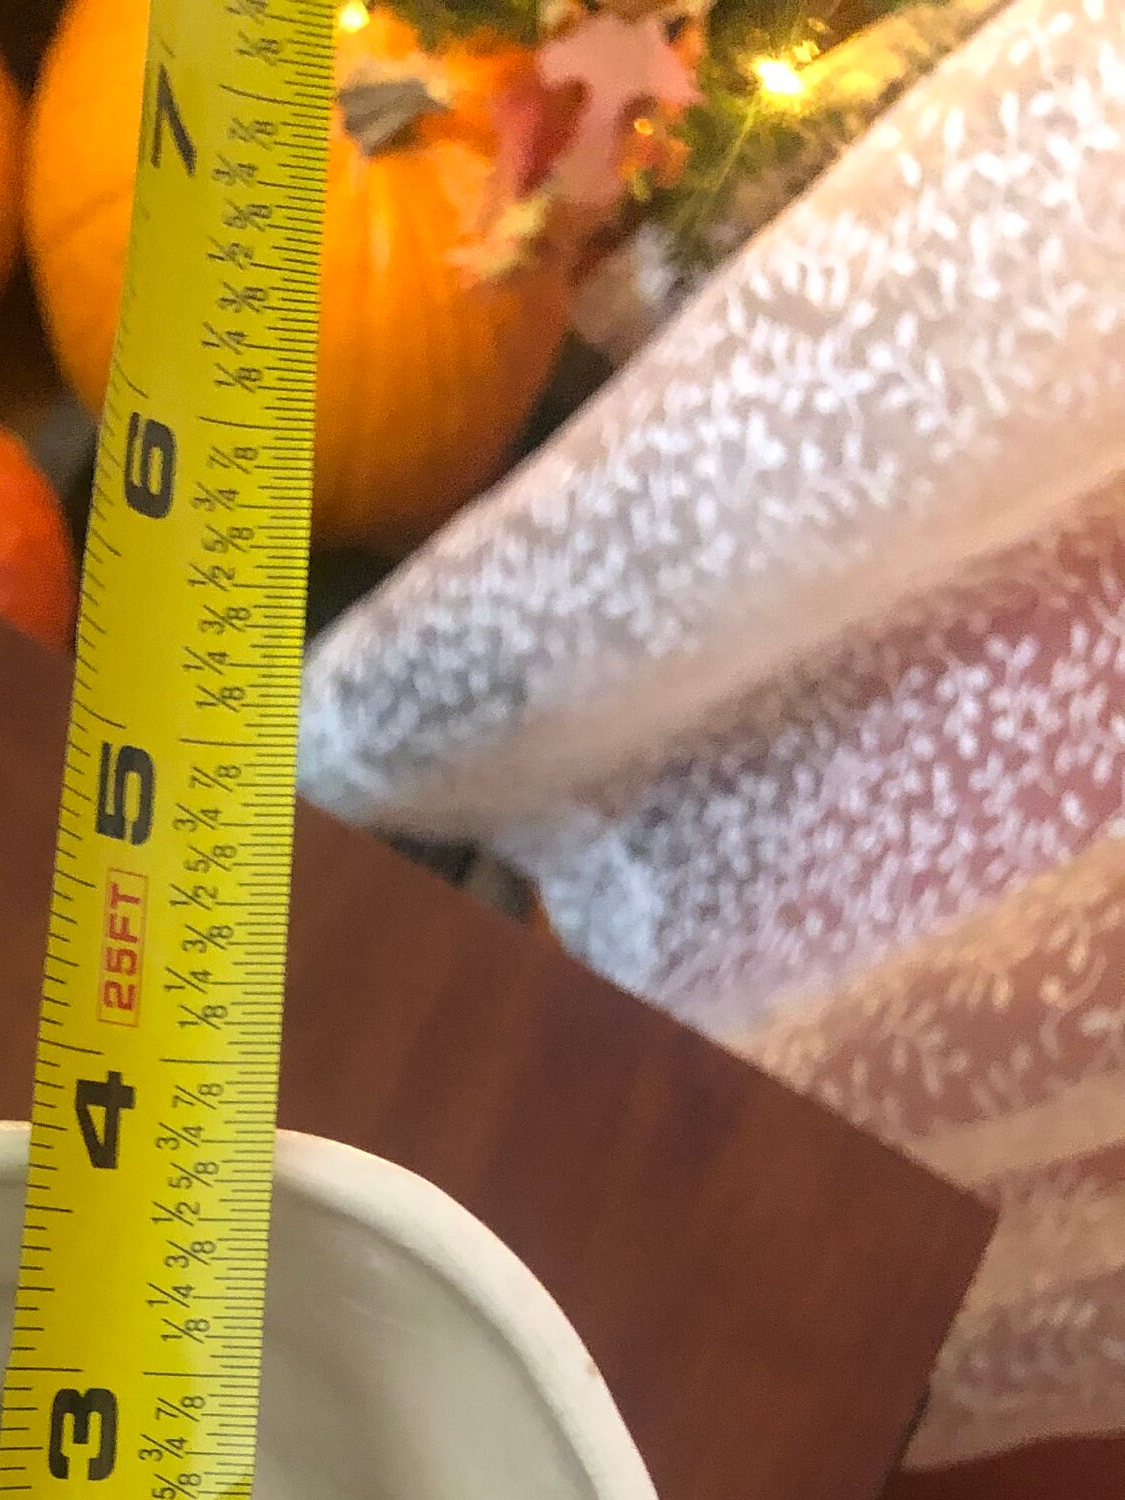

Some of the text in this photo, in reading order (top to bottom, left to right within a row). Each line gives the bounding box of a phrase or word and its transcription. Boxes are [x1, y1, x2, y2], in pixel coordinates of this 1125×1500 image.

[150, 63, 197, 177] 7
[124, 411, 177, 519] 6
[95, 741, 156, 846] 5
[102, 882, 142, 1011] 25FT
[75, 1070, 136, 1169] 4
[48, 1388, 119, 1481] 3
